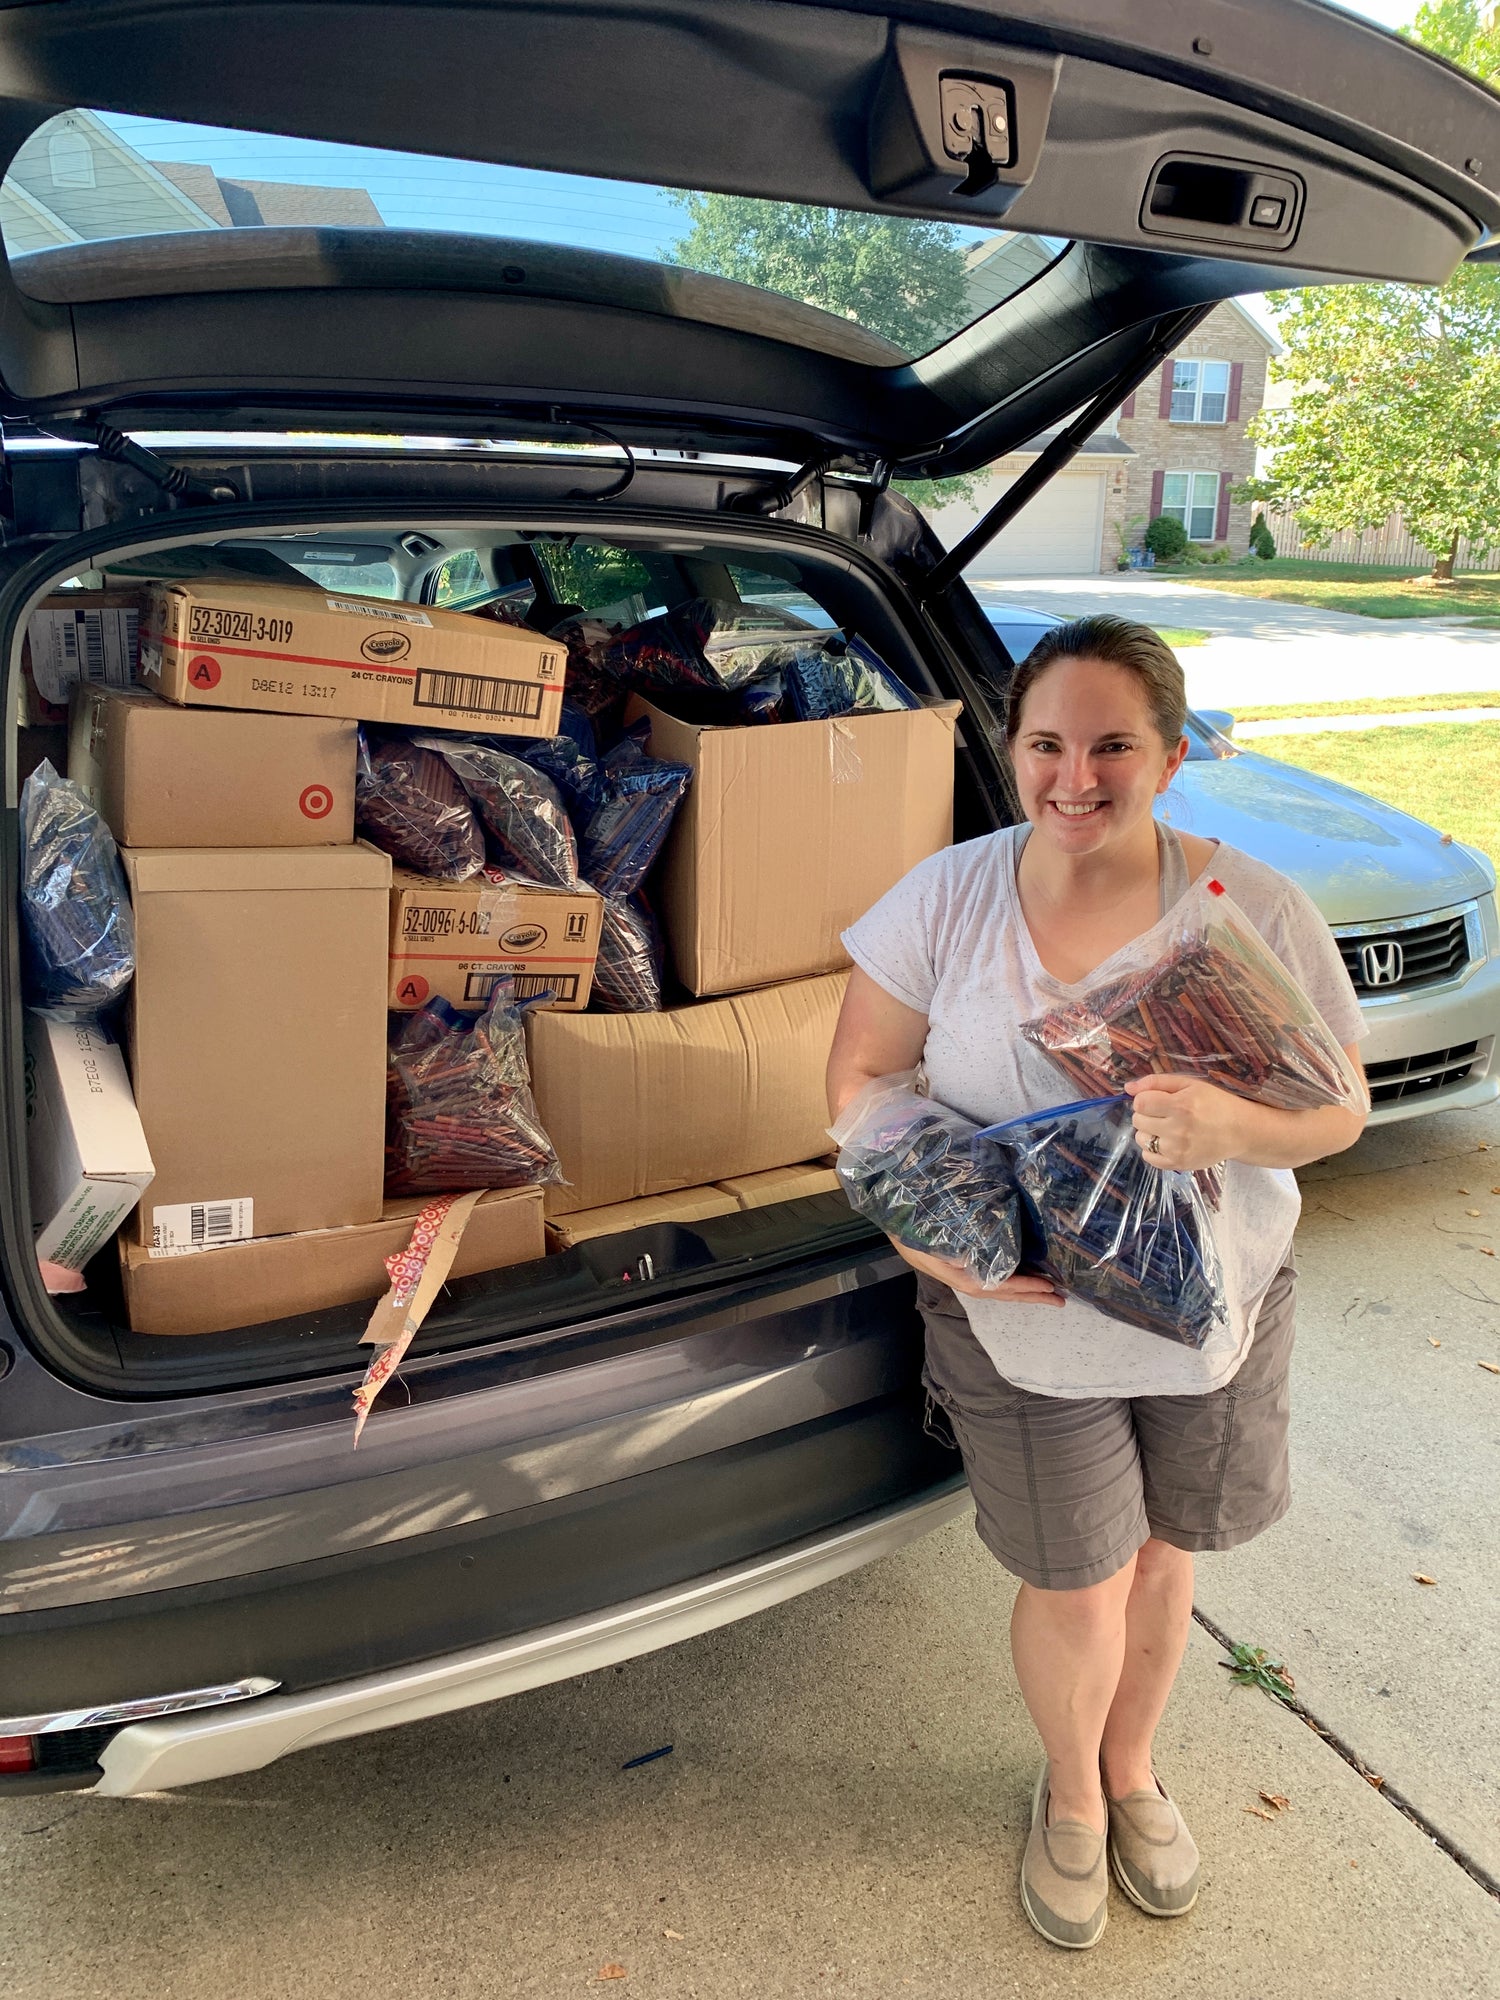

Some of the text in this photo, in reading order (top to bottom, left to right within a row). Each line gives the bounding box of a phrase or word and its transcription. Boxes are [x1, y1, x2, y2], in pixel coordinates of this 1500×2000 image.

[191, 609, 294, 644] 52-3024-3-019
[370, 638, 401, 650] Crayola
[194, 663, 211, 682] A
[351, 671, 413, 685] 24 CT. CRAYONS
[508, 929, 538, 942] Crayola
[458, 963, 527, 972] 96 CT. CRAYONS
[401, 982, 418, 998] A
[73, 1205, 96, 1229] CRAYONS
